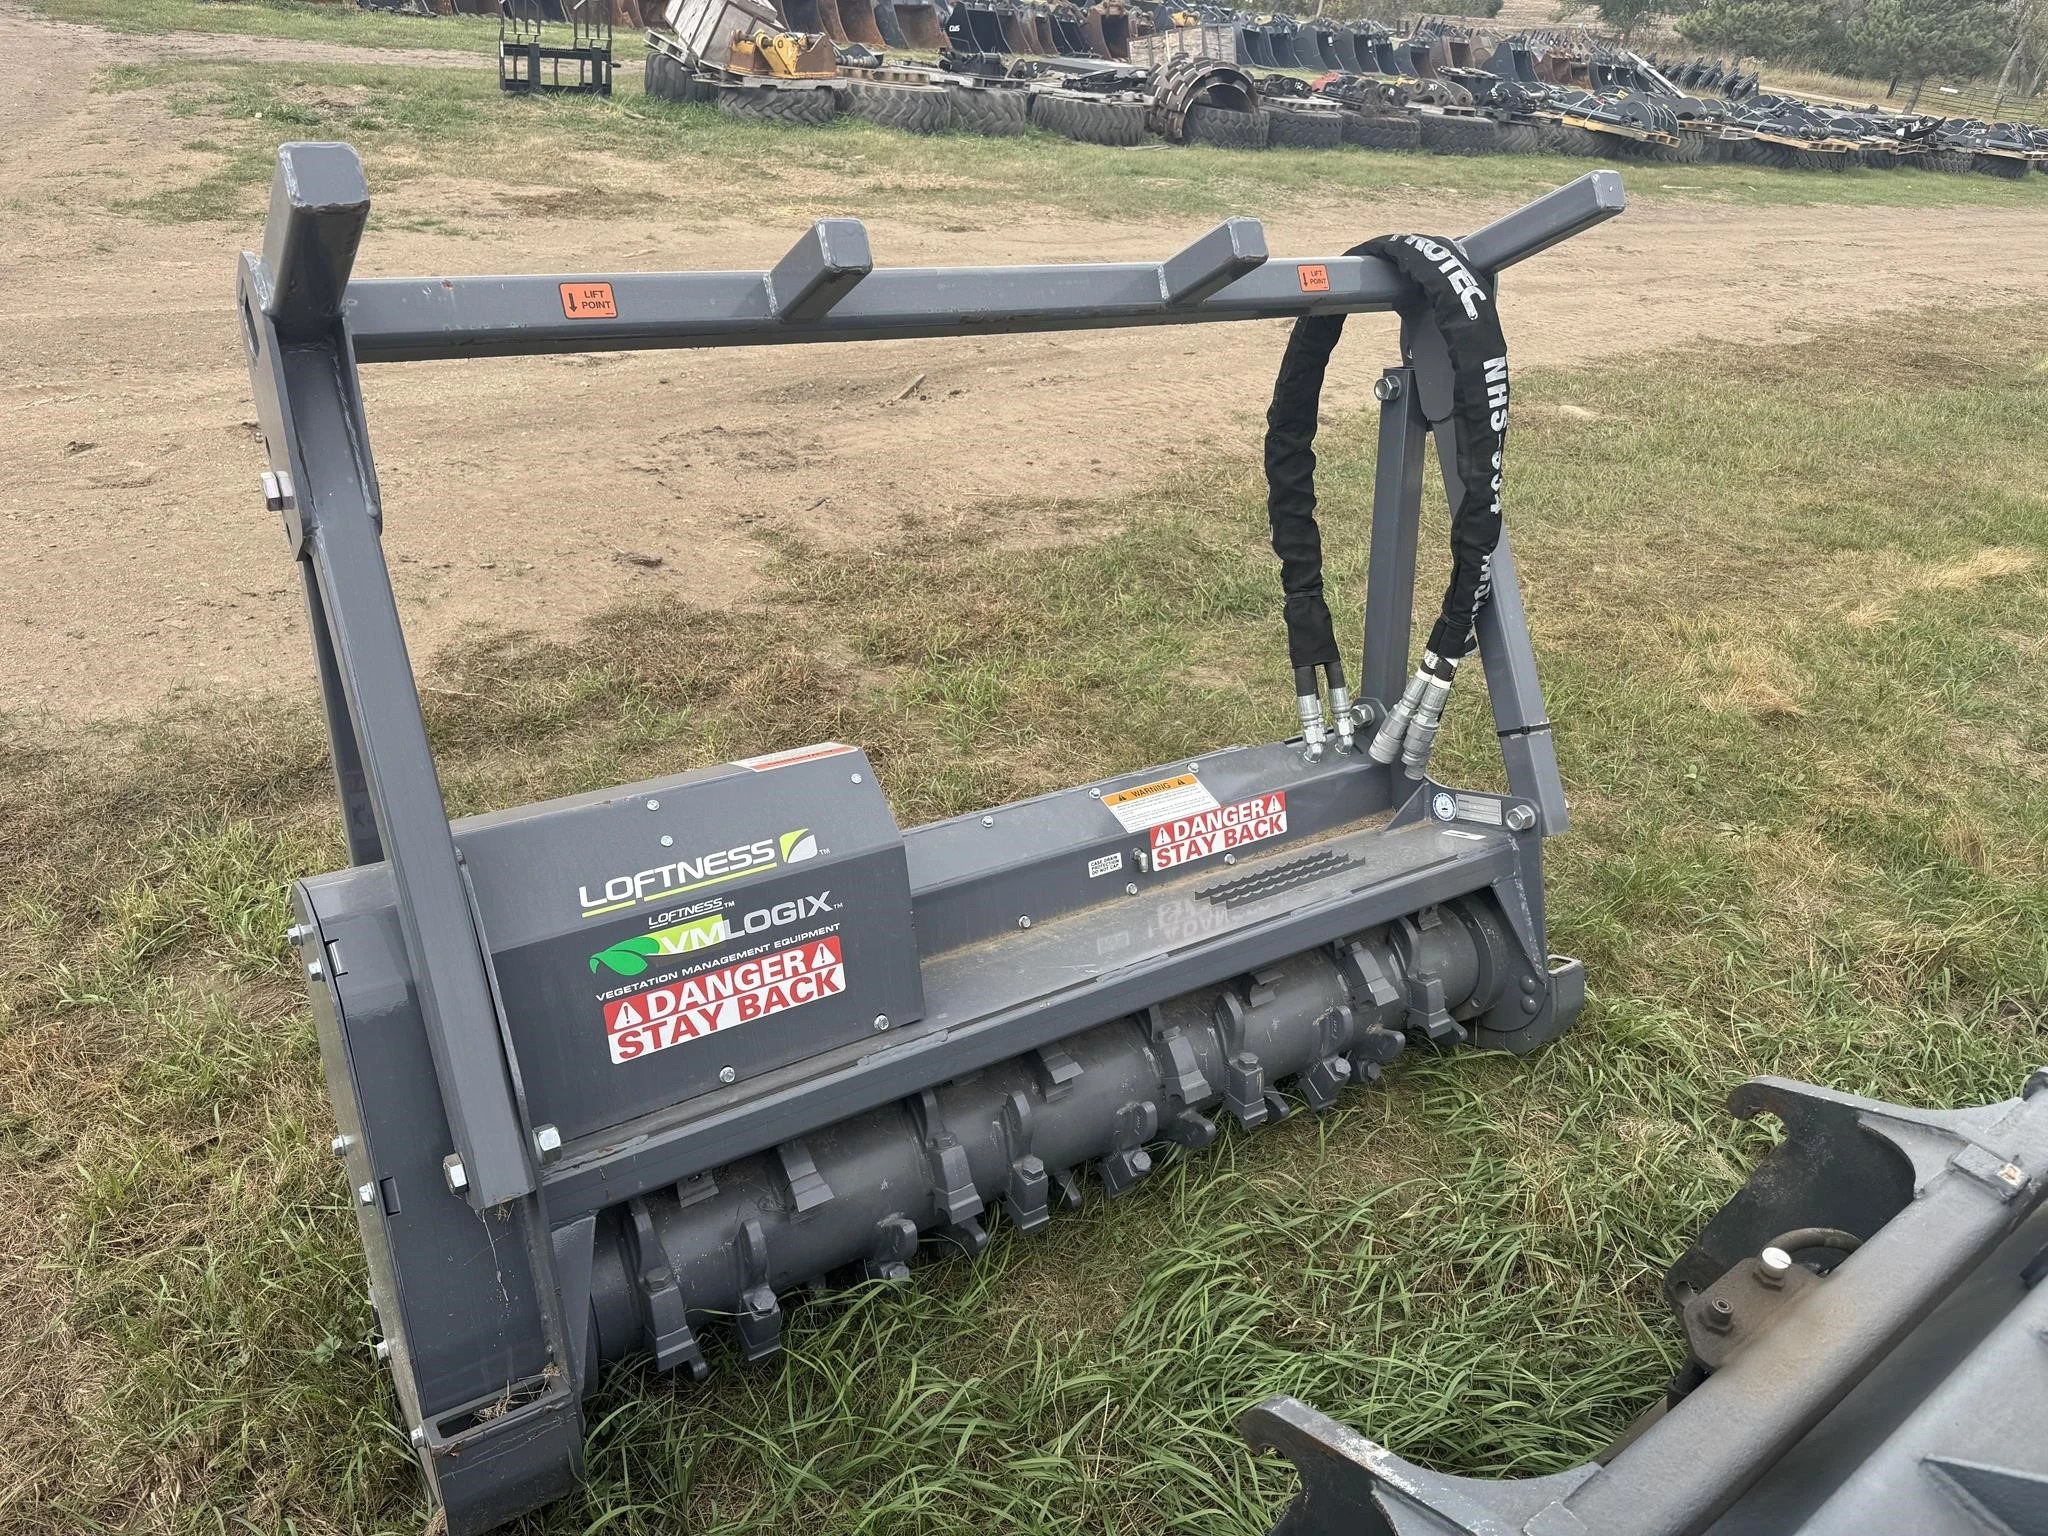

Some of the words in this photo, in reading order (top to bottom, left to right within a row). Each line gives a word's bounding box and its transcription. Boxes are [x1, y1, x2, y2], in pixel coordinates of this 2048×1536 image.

[581, 301, 611, 309] POINT
[583, 290, 604, 298] LIFT
[1131, 782, 1171, 797] WARNING
[1156, 833, 1217, 868] STAY
[1224, 814, 1284, 846] BACK
[1173, 799, 1265, 841] DANGER
[578, 838, 776, 908] LOFTNESS
[648, 897, 723, 926] LOFTNESS
[596, 970, 678, 1001] VEGETATION
[681, 943, 771, 975] MANAGEMENT
[774, 922, 841, 949] EQUIPMENT
[646, 949, 807, 1020] DANGER
[616, 1004, 725, 1059] STAY
[737, 967, 839, 1022] BACK
